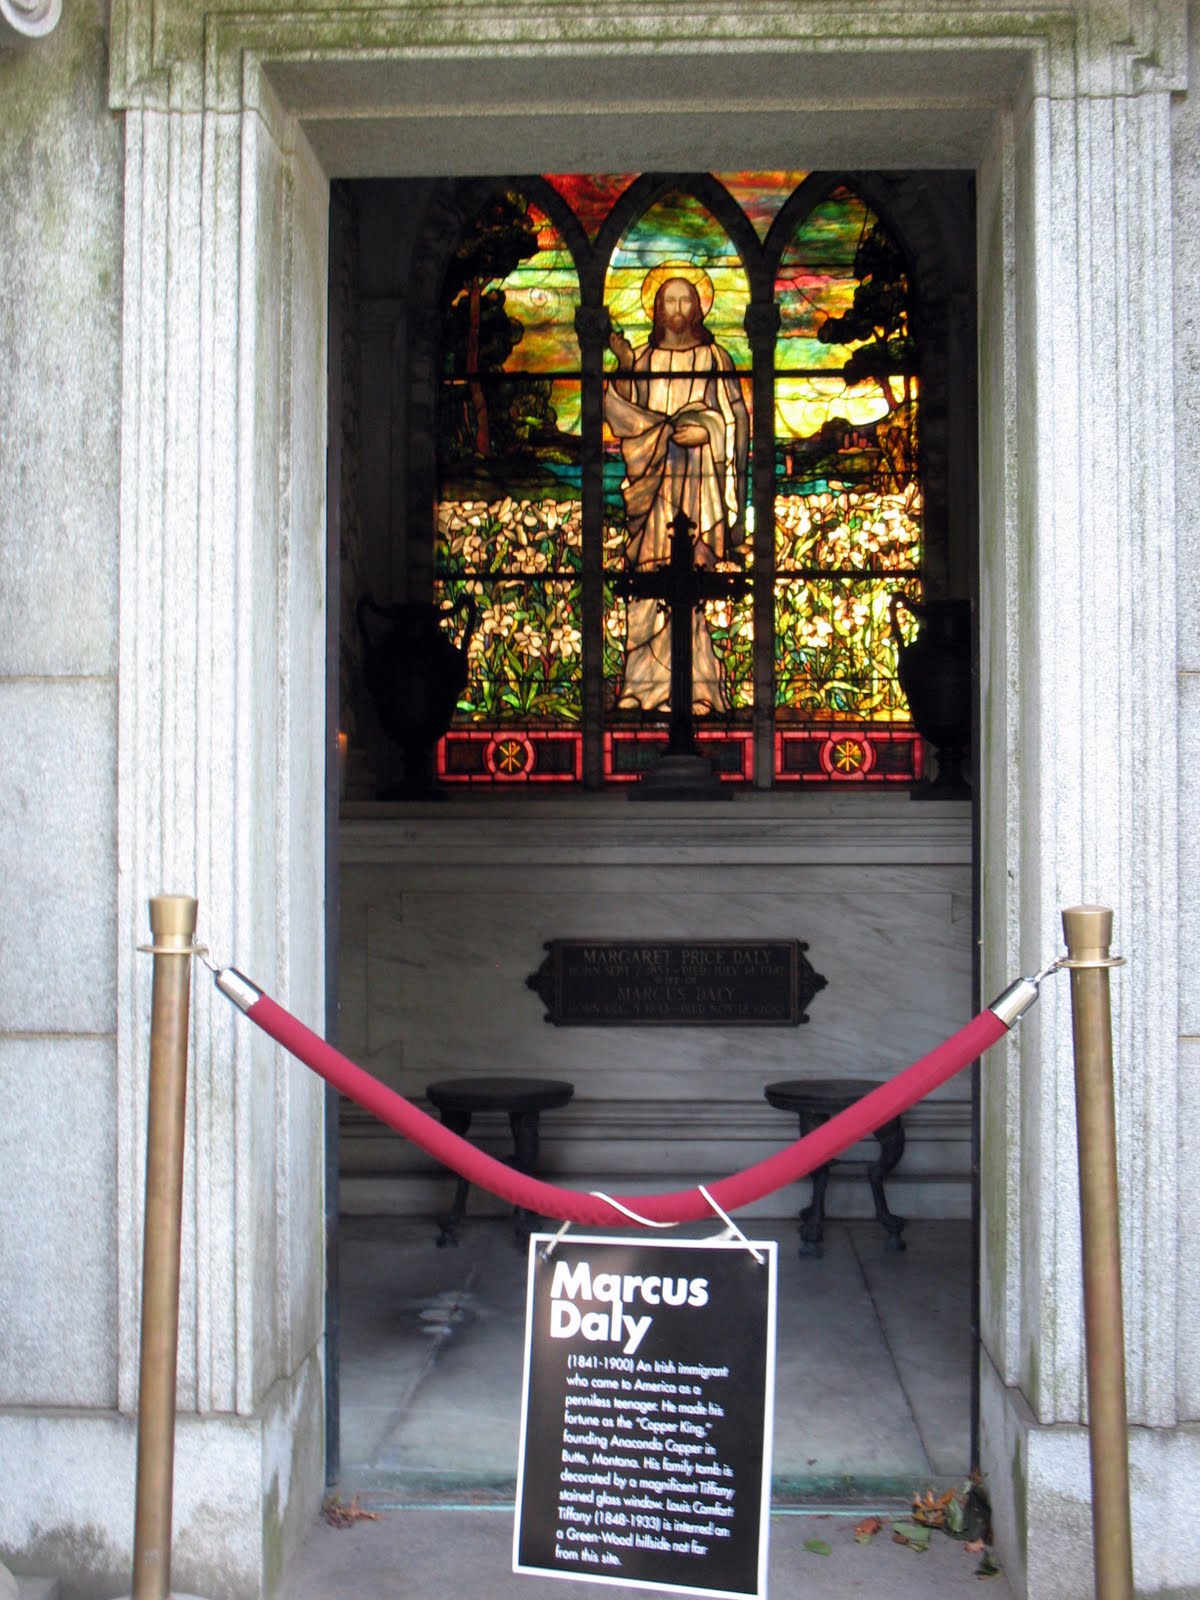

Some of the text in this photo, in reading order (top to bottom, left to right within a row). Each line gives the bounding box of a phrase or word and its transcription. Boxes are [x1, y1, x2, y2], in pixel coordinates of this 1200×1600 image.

[583, 949, 771, 964] MARGARET PRICE DALY
[550, 1260, 709, 1306] Marcus
[550, 1299, 652, 1354] Daly
[567, 1354, 729, 1380] (1841-1900) An Irish immigrant
[566, 1372, 702, 1395] who came to America as a
[565, 1393, 612, 1408] penniless
[661, 1400, 677, 1413] He
[678, 1401, 708, 1416] made
[708, 1401, 725, 1417] his
[564, 1410, 600, 1427] fortune
[602, 1417, 615, 1428] as
[617, 1415, 633, 1429] the
[563, 1429, 717, 1456] founding Anaconda Copper in
[643, 1457, 660, 1470] His
[662, 1458, 694, 1476] family
[695, 1461, 722, 1476] tomb
[723, 1464, 734, 1477] is
[560, 1467, 736, 1500] decorated by a magnificent Tiffany
[559, 1489, 594, 1504] stained
[596, 1491, 622, 1508] glass
[666, 1499, 692, 1513] Louis
[692, 1501, 734, 1517] Comfort
[557, 1506, 592, 1526] Tiffany
[663, 1518, 672, 1532] is
[673, 1519, 714, 1535] interred
[555, 1543, 578, 1561] from
[581, 1547, 600, 1563] this
[556, 1529, 564, 1540] a
[566, 1528, 634, 1547] Green-Wood
[635, 1533, 671, 1552] hillside
[672, 1541, 690, 1553] not
